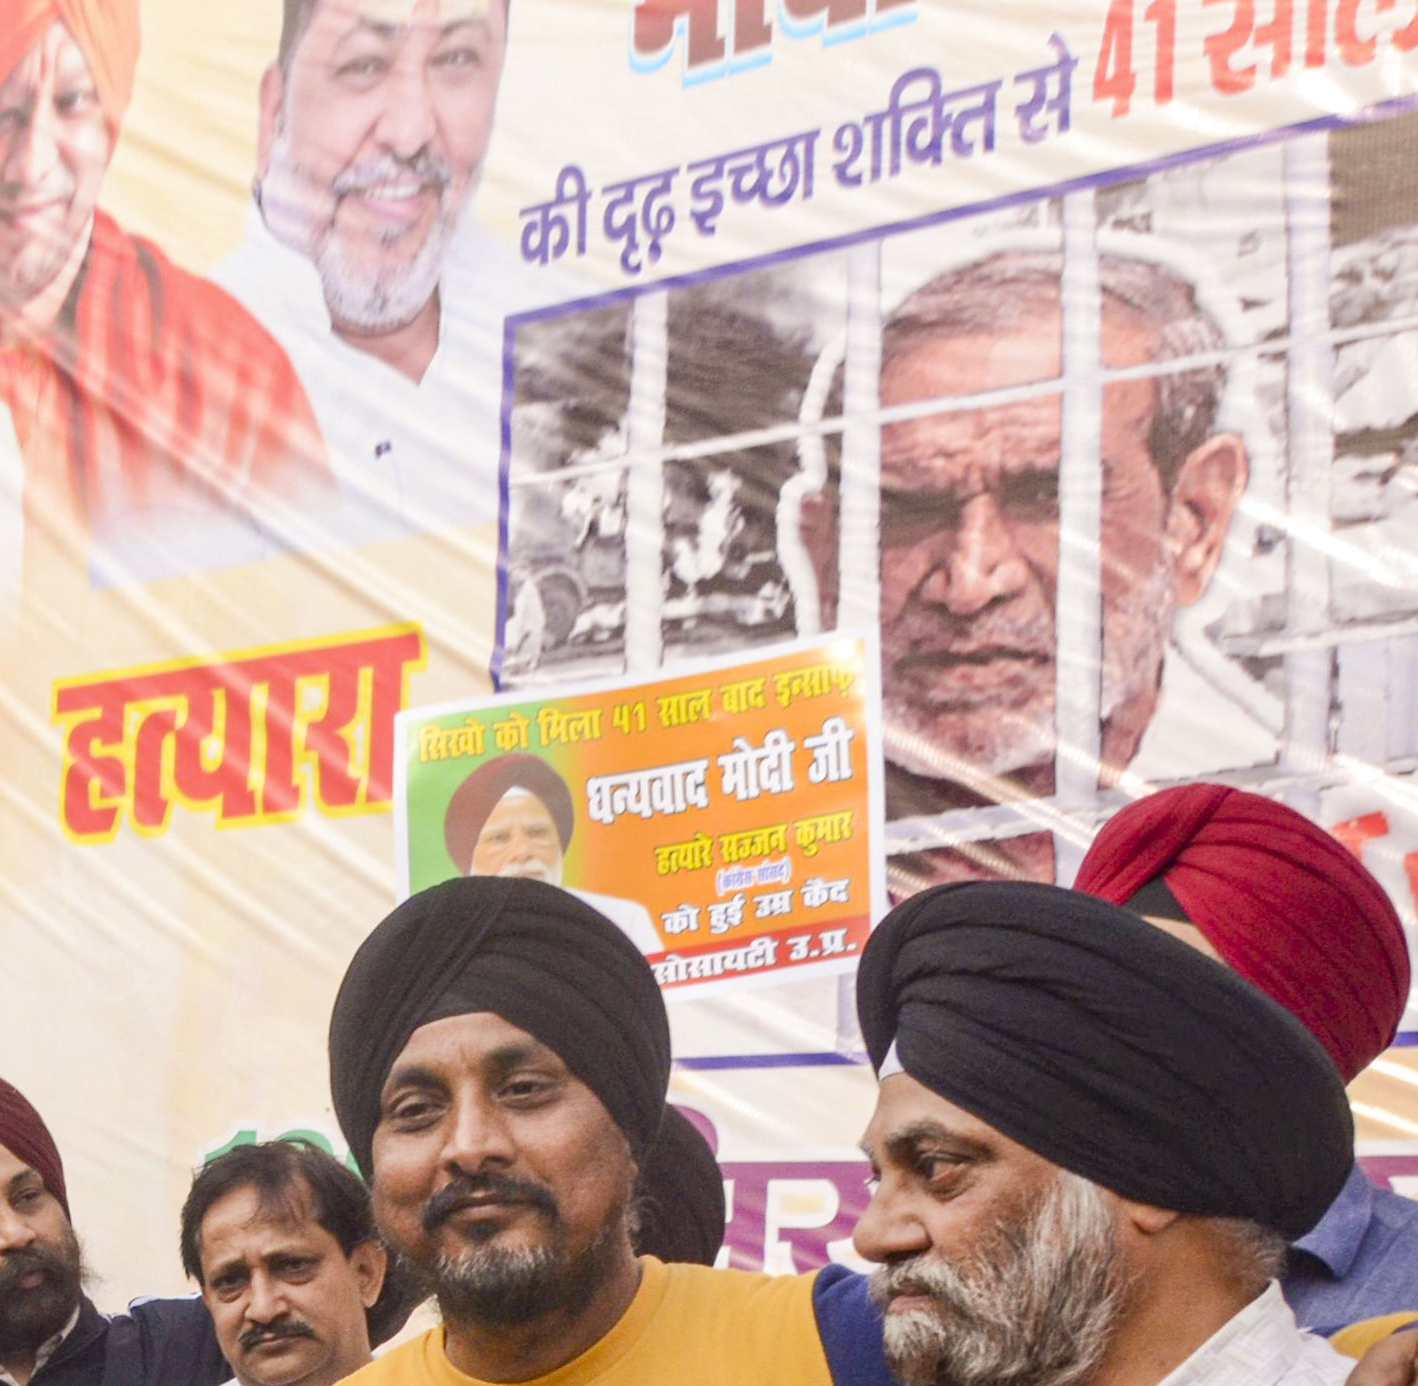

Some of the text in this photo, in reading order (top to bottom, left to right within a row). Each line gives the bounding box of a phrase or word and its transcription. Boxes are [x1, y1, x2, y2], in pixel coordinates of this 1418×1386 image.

[519, 164, 593, 267] की
[686, 127, 820, 235] इच्छा
[832, 67, 1003, 188] शक्ति
[1013, 31, 1080, 144] से
[1092, 0, 1176, 119] 41
[53, 624, 425, 842] हत्यारा
[494, 712, 530, 751] को
[537, 707, 603, 746] मिला
[613, 701, 647, 735] 41
[657, 688, 713, 727] साल
[720, 677, 766, 714] बाद
[587, 715, 855, 824] धन्यवाद मोदी जी
[655, 810, 855, 876] हत्यारे सज्जन कुमार
[661, 903, 700, 934] को
[708, 893, 747, 935] हुई
[753, 889, 794, 918] उम्र
